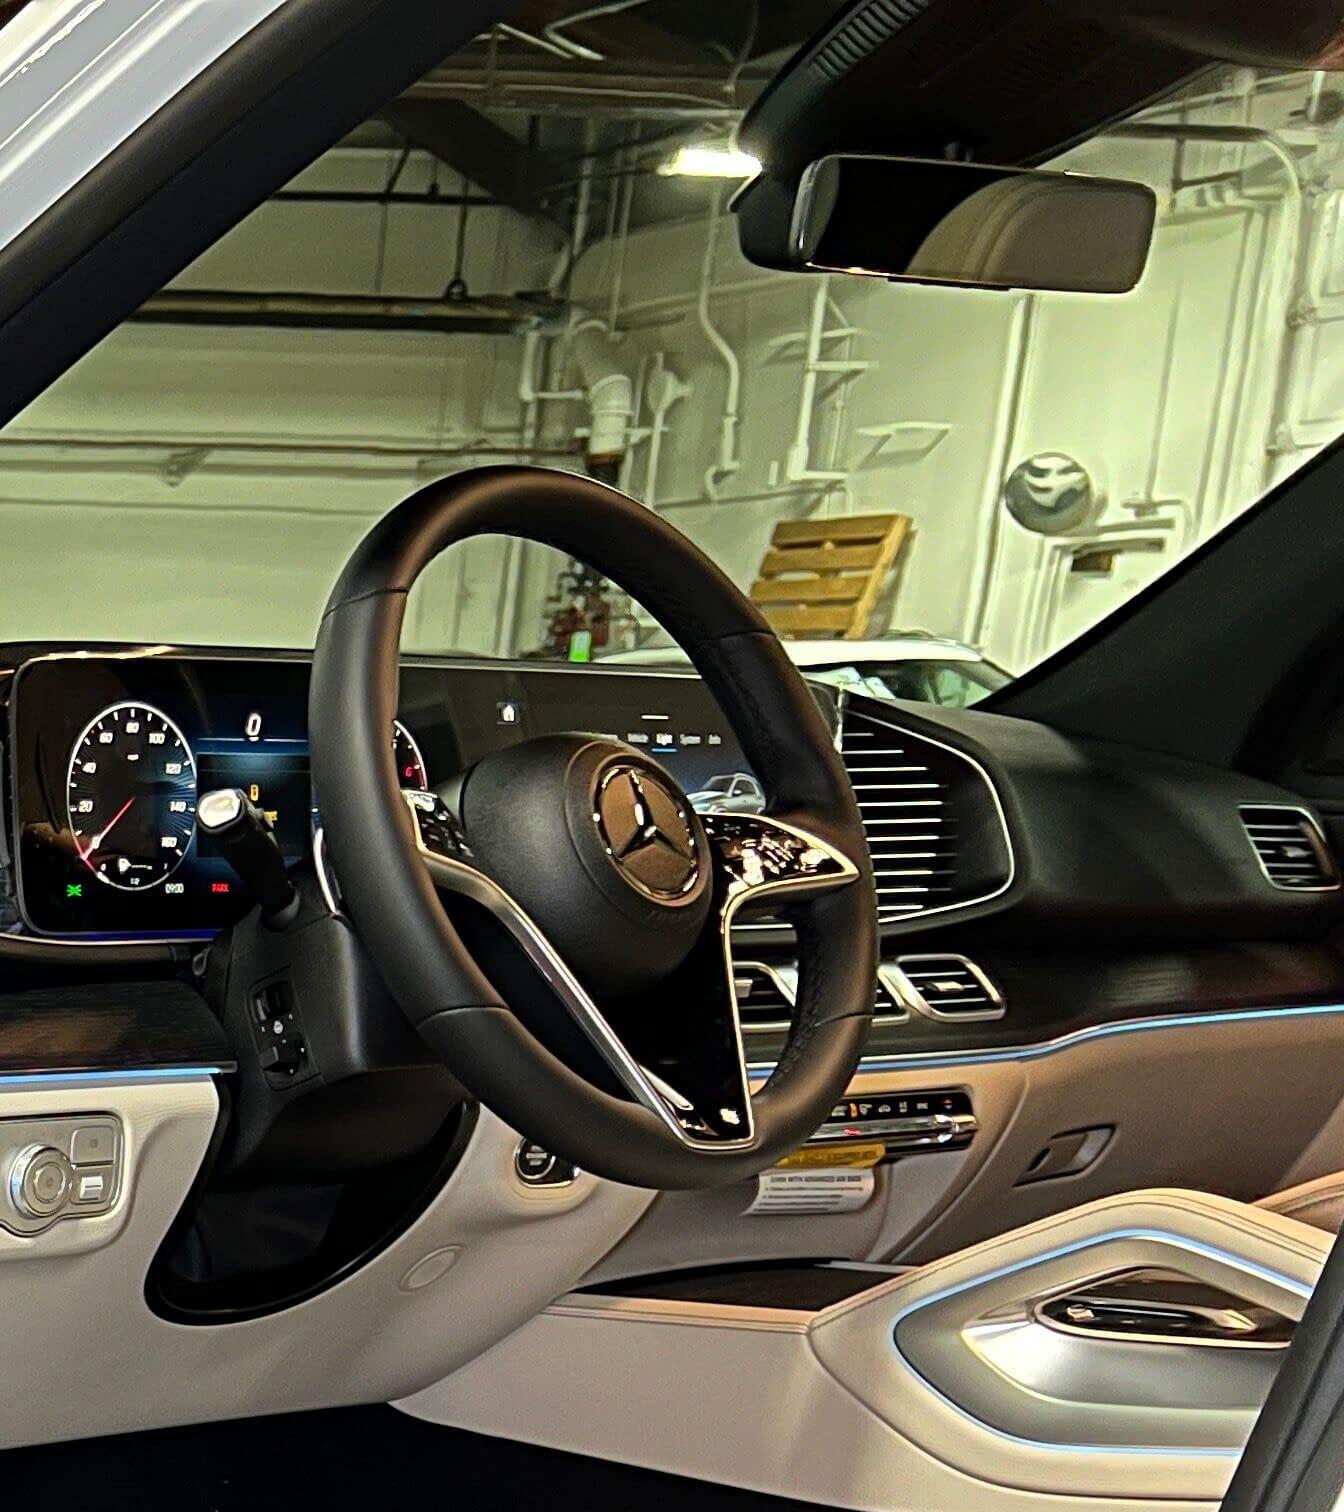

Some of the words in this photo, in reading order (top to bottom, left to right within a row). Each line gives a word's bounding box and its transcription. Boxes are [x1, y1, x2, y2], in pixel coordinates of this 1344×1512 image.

[245, 712, 262, 735] 0
[148, 732, 165, 744] 100
[165, 763, 182, 774] 120
[78, 800, 93, 812] 20
[170, 801, 186, 812] 140
